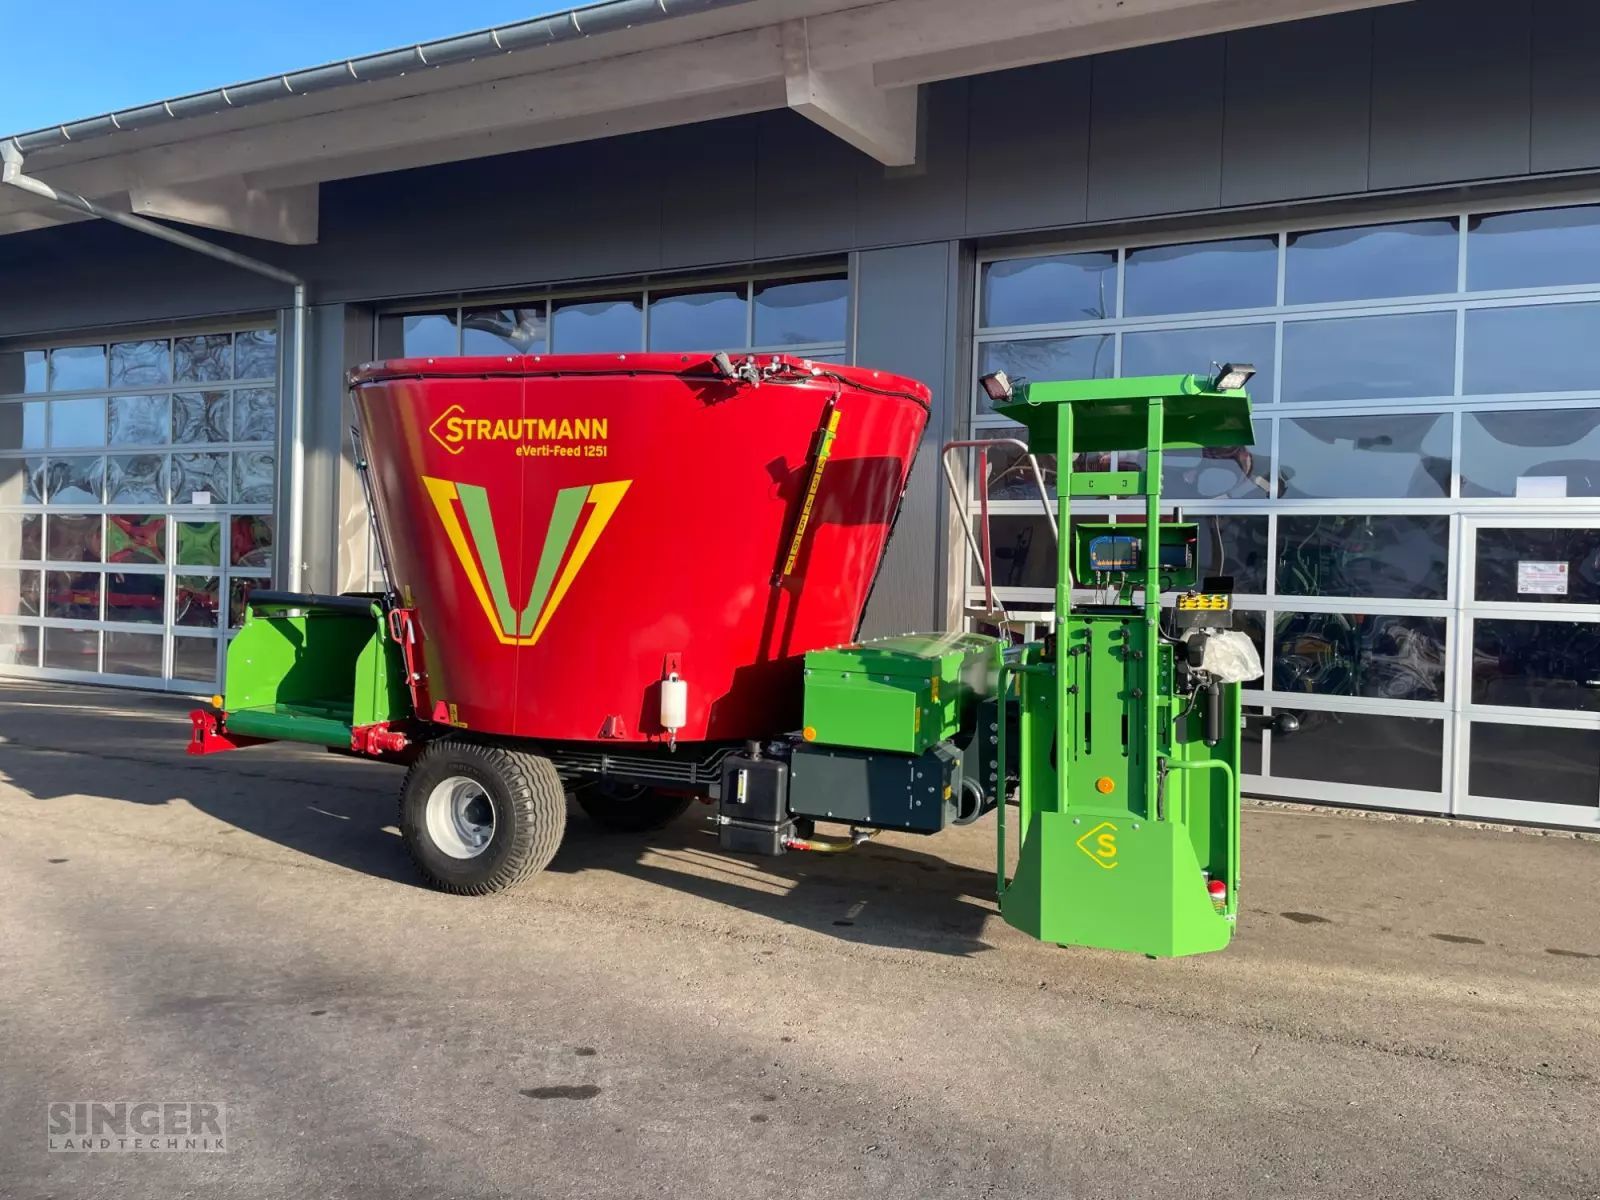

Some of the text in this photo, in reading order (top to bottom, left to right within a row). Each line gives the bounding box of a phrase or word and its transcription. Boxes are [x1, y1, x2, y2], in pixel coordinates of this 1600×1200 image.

[446, 417, 607, 442] STRAUTMANN
[515, 445, 608, 457] eVerti-Feed 1251
[1097, 834, 1116, 857] S
